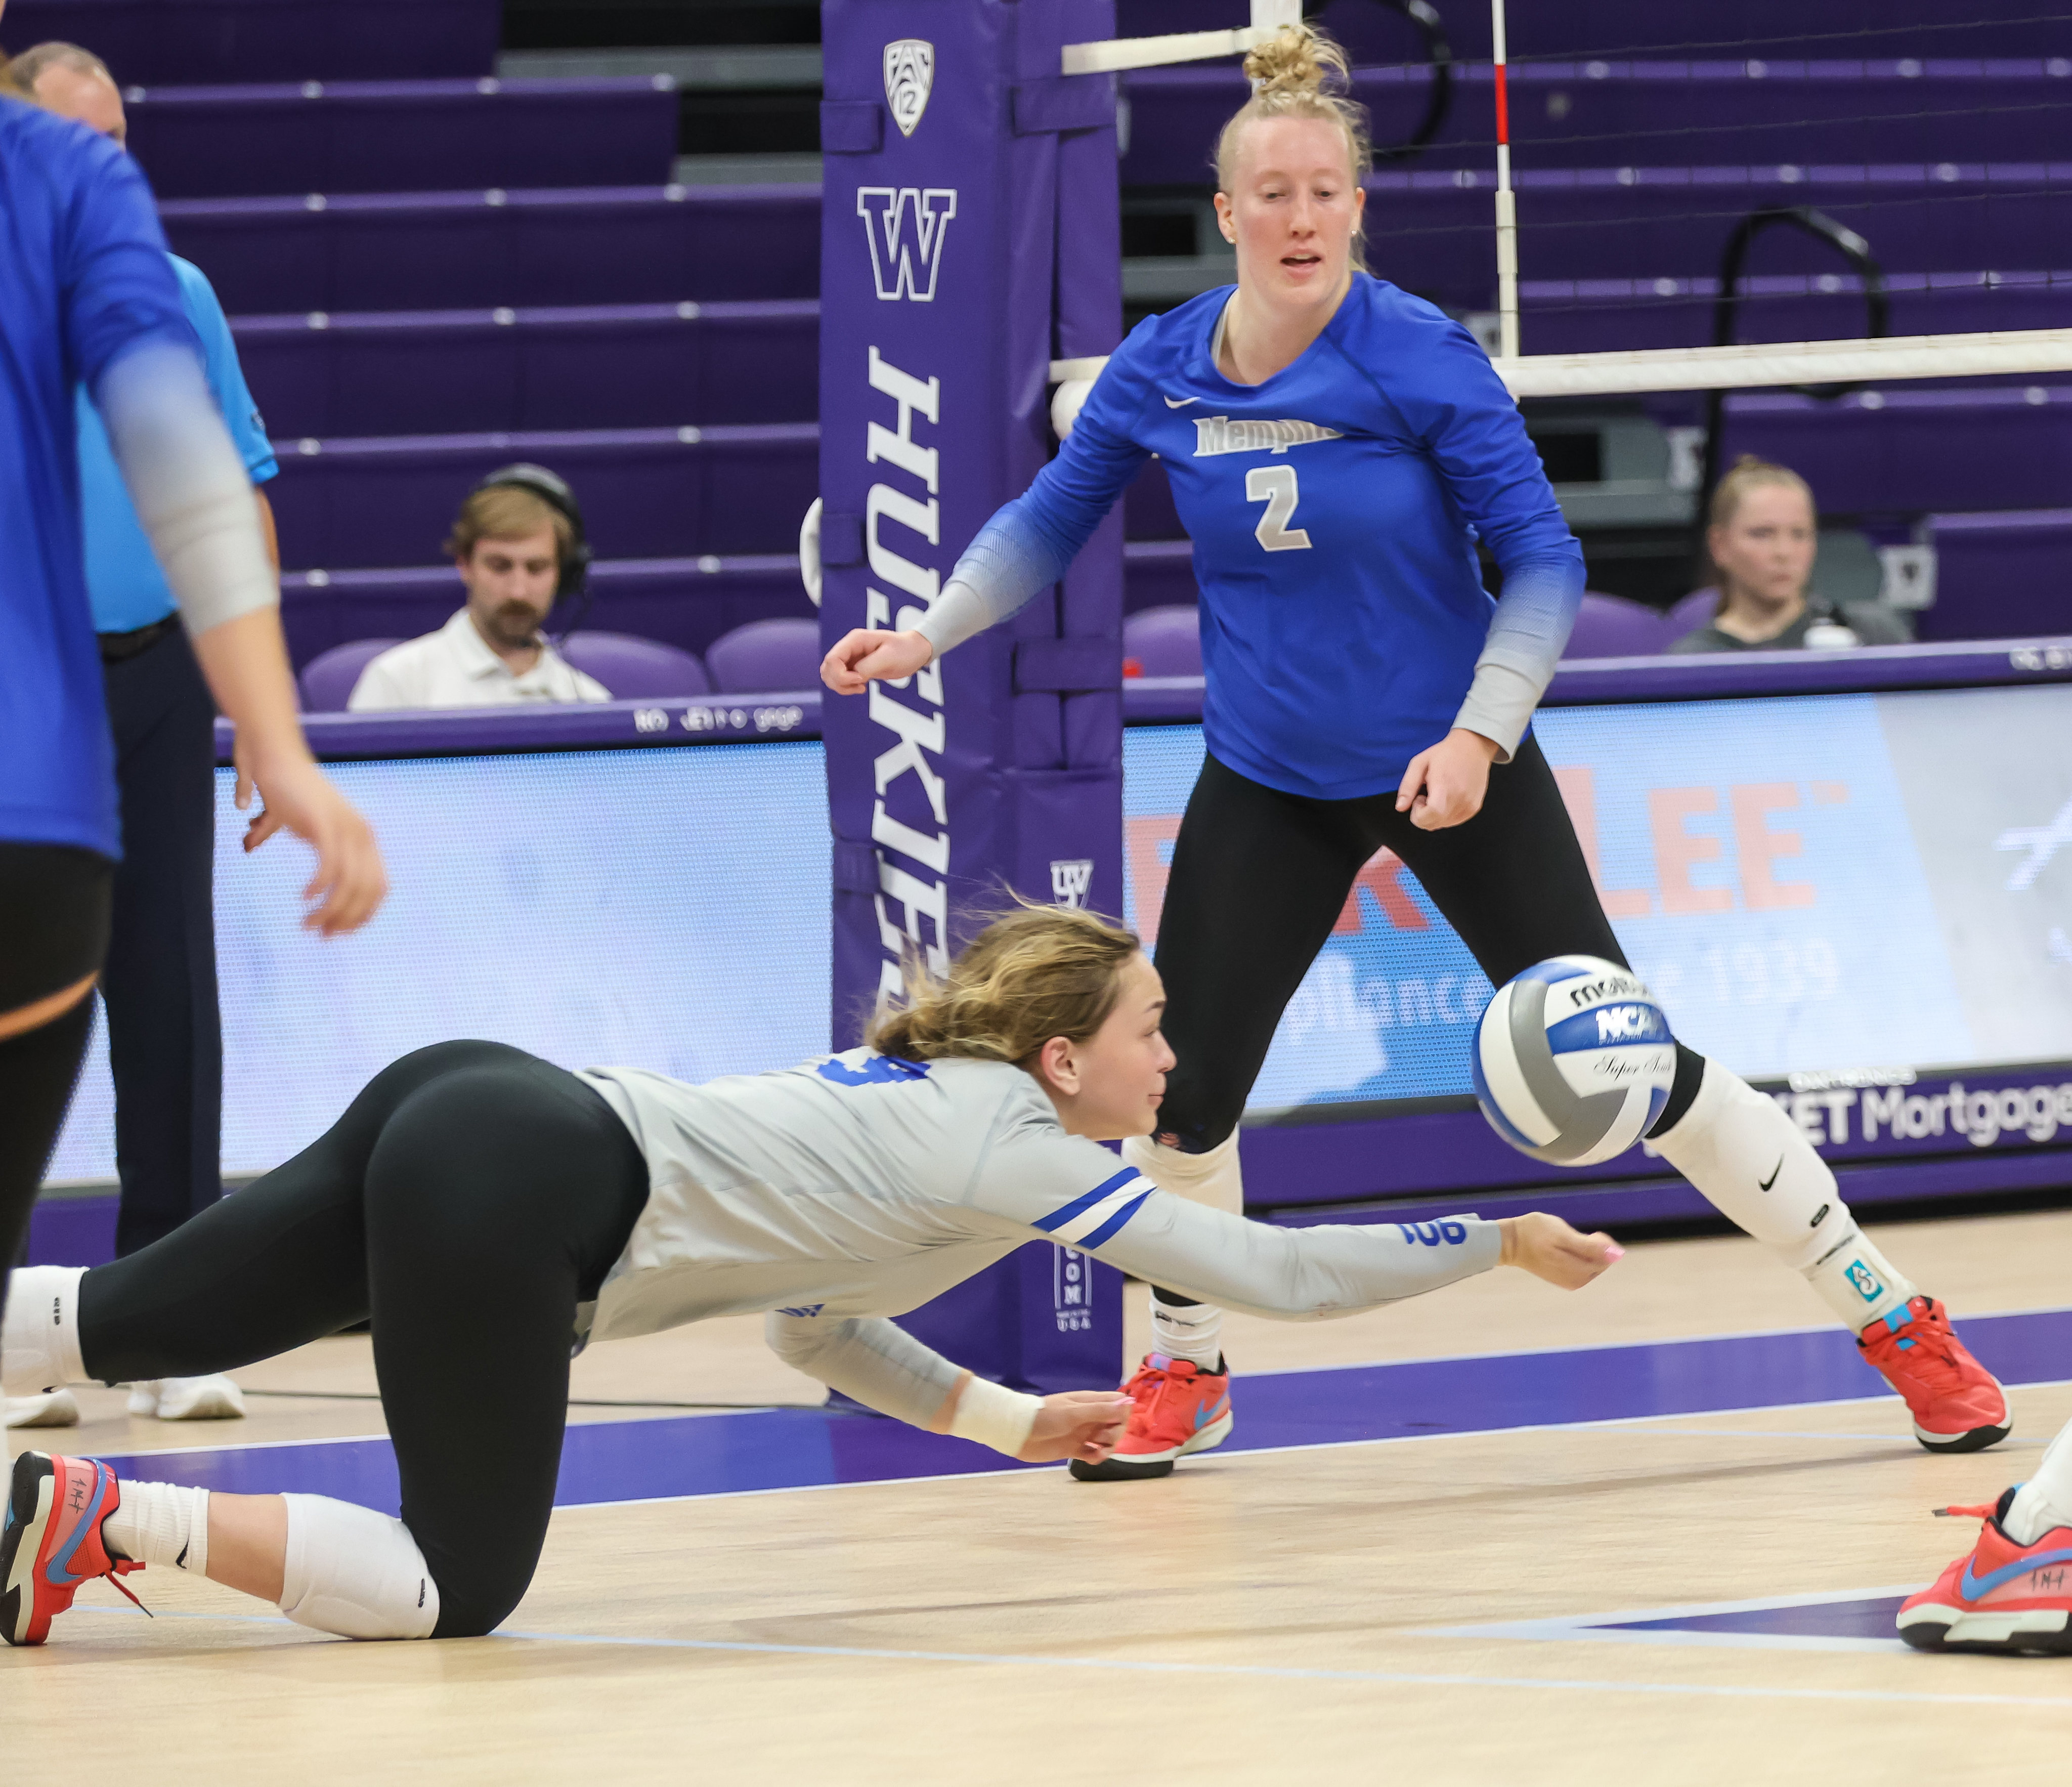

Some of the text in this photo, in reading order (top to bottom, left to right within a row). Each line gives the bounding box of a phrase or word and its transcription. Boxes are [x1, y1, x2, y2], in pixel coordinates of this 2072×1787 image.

[857, 186, 958, 302] W
[1245, 464, 1313, 552] 2
[1550, 764, 1816, 921] LEE
[1285, 954, 1495, 1045] pliance
